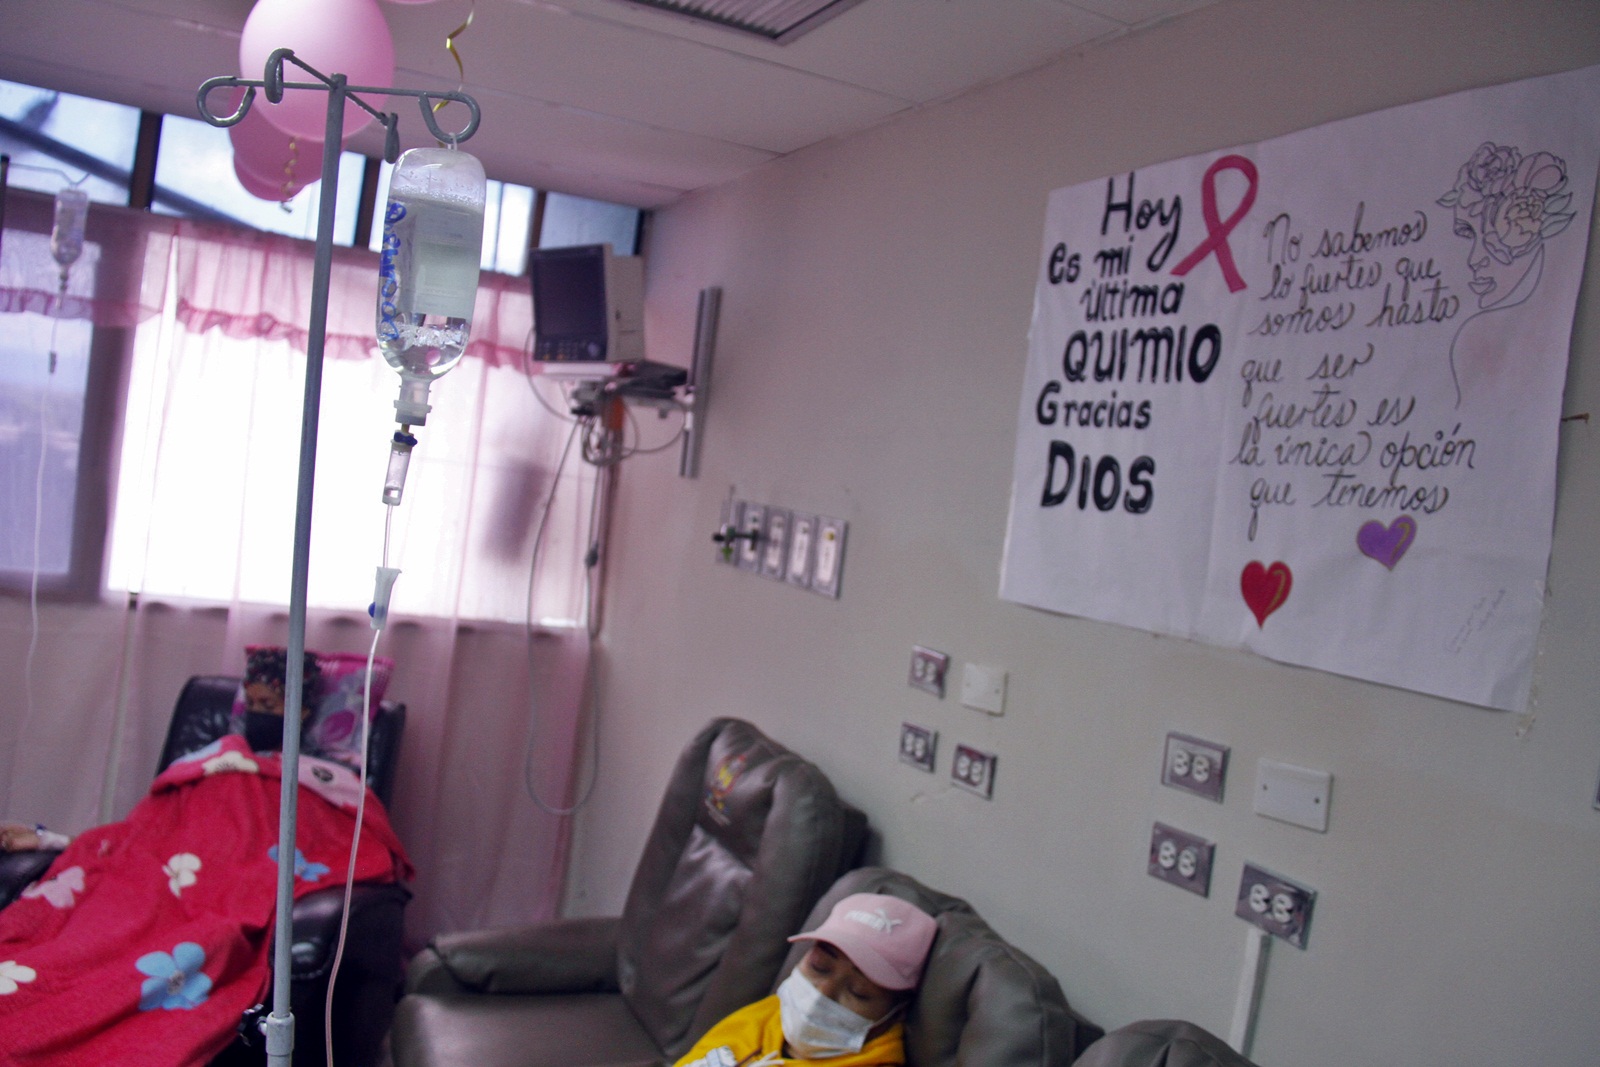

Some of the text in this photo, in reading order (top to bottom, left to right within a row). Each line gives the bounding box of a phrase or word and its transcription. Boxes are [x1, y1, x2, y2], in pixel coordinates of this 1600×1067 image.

[1101, 170, 1182, 272] Hoy
[1262, 201, 1427, 265] No sabemos
[1048, 236, 1135, 285] es mi
[1260, 254, 1441, 312] lo fuertes que
[1079, 279, 1185, 321] última
[1248, 279, 1460, 336] somos hasta
[1063, 323, 1221, 383] QUIMIO
[1241, 342, 1375, 408] que ser
[1036, 380, 1152, 430] Gracias
[1253, 382, 1415, 444] fuertes es
[1040, 440, 1155, 514] DIOS
[1228, 421, 1265, 466] la
[1380, 422, 1476, 486] opción
[1249, 469, 1449, 542] que tenemos
